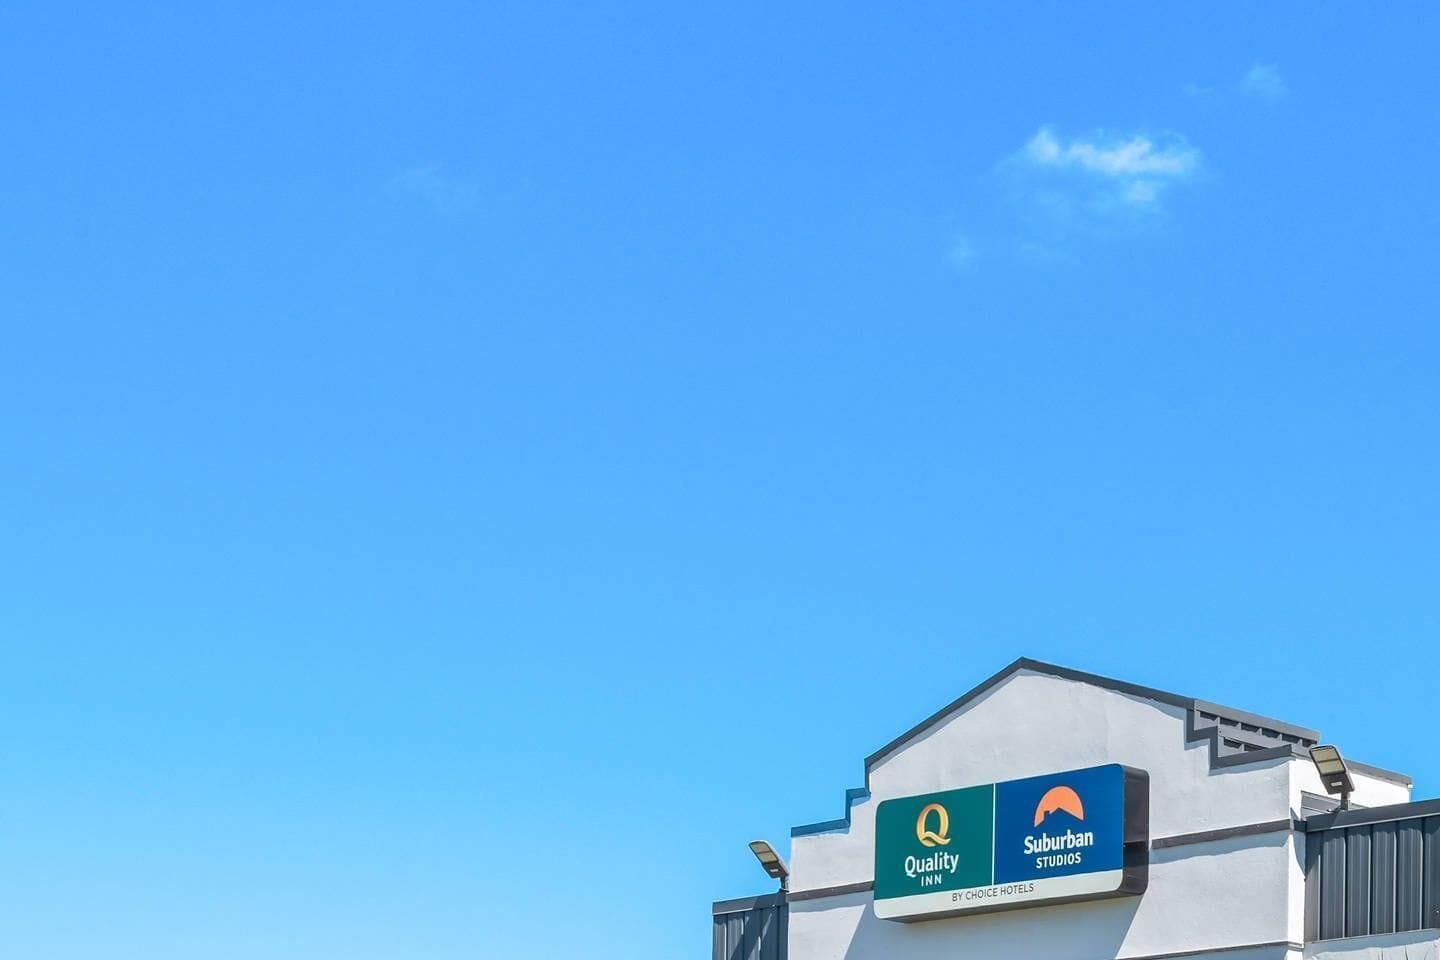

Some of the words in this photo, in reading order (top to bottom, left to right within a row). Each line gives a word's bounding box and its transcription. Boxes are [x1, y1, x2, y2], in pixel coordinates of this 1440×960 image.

[916, 803, 951, 847] Q
[1023, 829, 1094, 855] Suburban
[904, 851, 959, 878] Quality
[1036, 852, 1082, 869] STUDIOS
[921, 873, 942, 887] INN
[952, 892, 963, 902] BY
[965, 887, 998, 900] CHOICE
[1000, 883, 1034, 896] HOTELS
